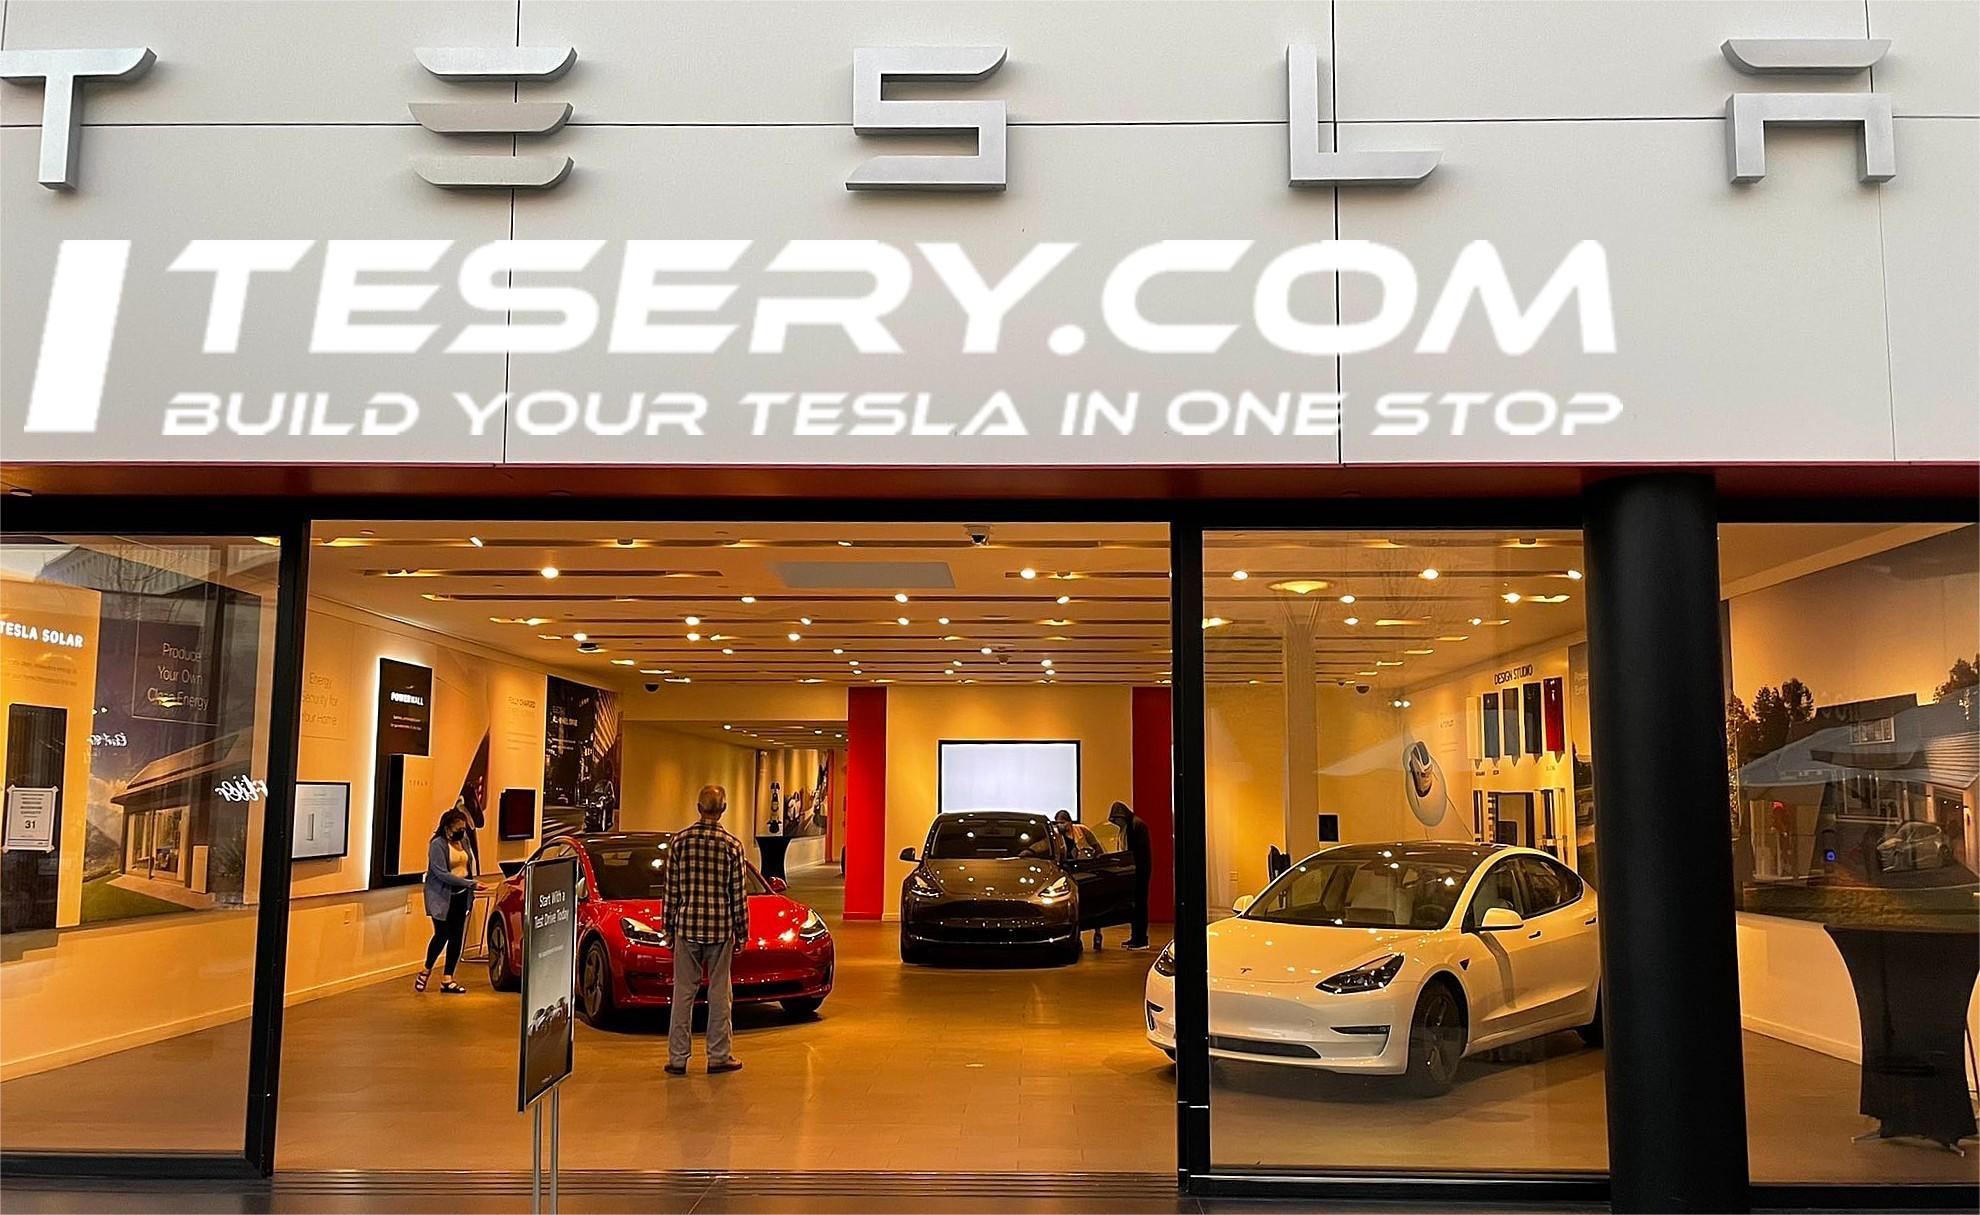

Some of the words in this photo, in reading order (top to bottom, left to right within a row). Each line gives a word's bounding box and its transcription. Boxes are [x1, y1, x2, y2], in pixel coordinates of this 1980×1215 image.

[0, 38, 1896, 190] TESLA
[0, 621, 38, 641] TESLA
[42, 629, 84, 648] SOLAR
[162, 642, 202, 662] Produce
[157, 665, 179, 681] Your
[181, 669, 203, 685] Own
[1494, 670, 1513, 685] DESIGN
[1513, 664, 1533, 680] STUDIO
[177, 691, 209, 711] Energy
[25, 820, 36, 829] 31
[539, 894, 551, 908] Start
[534, 914, 544, 929] Test
